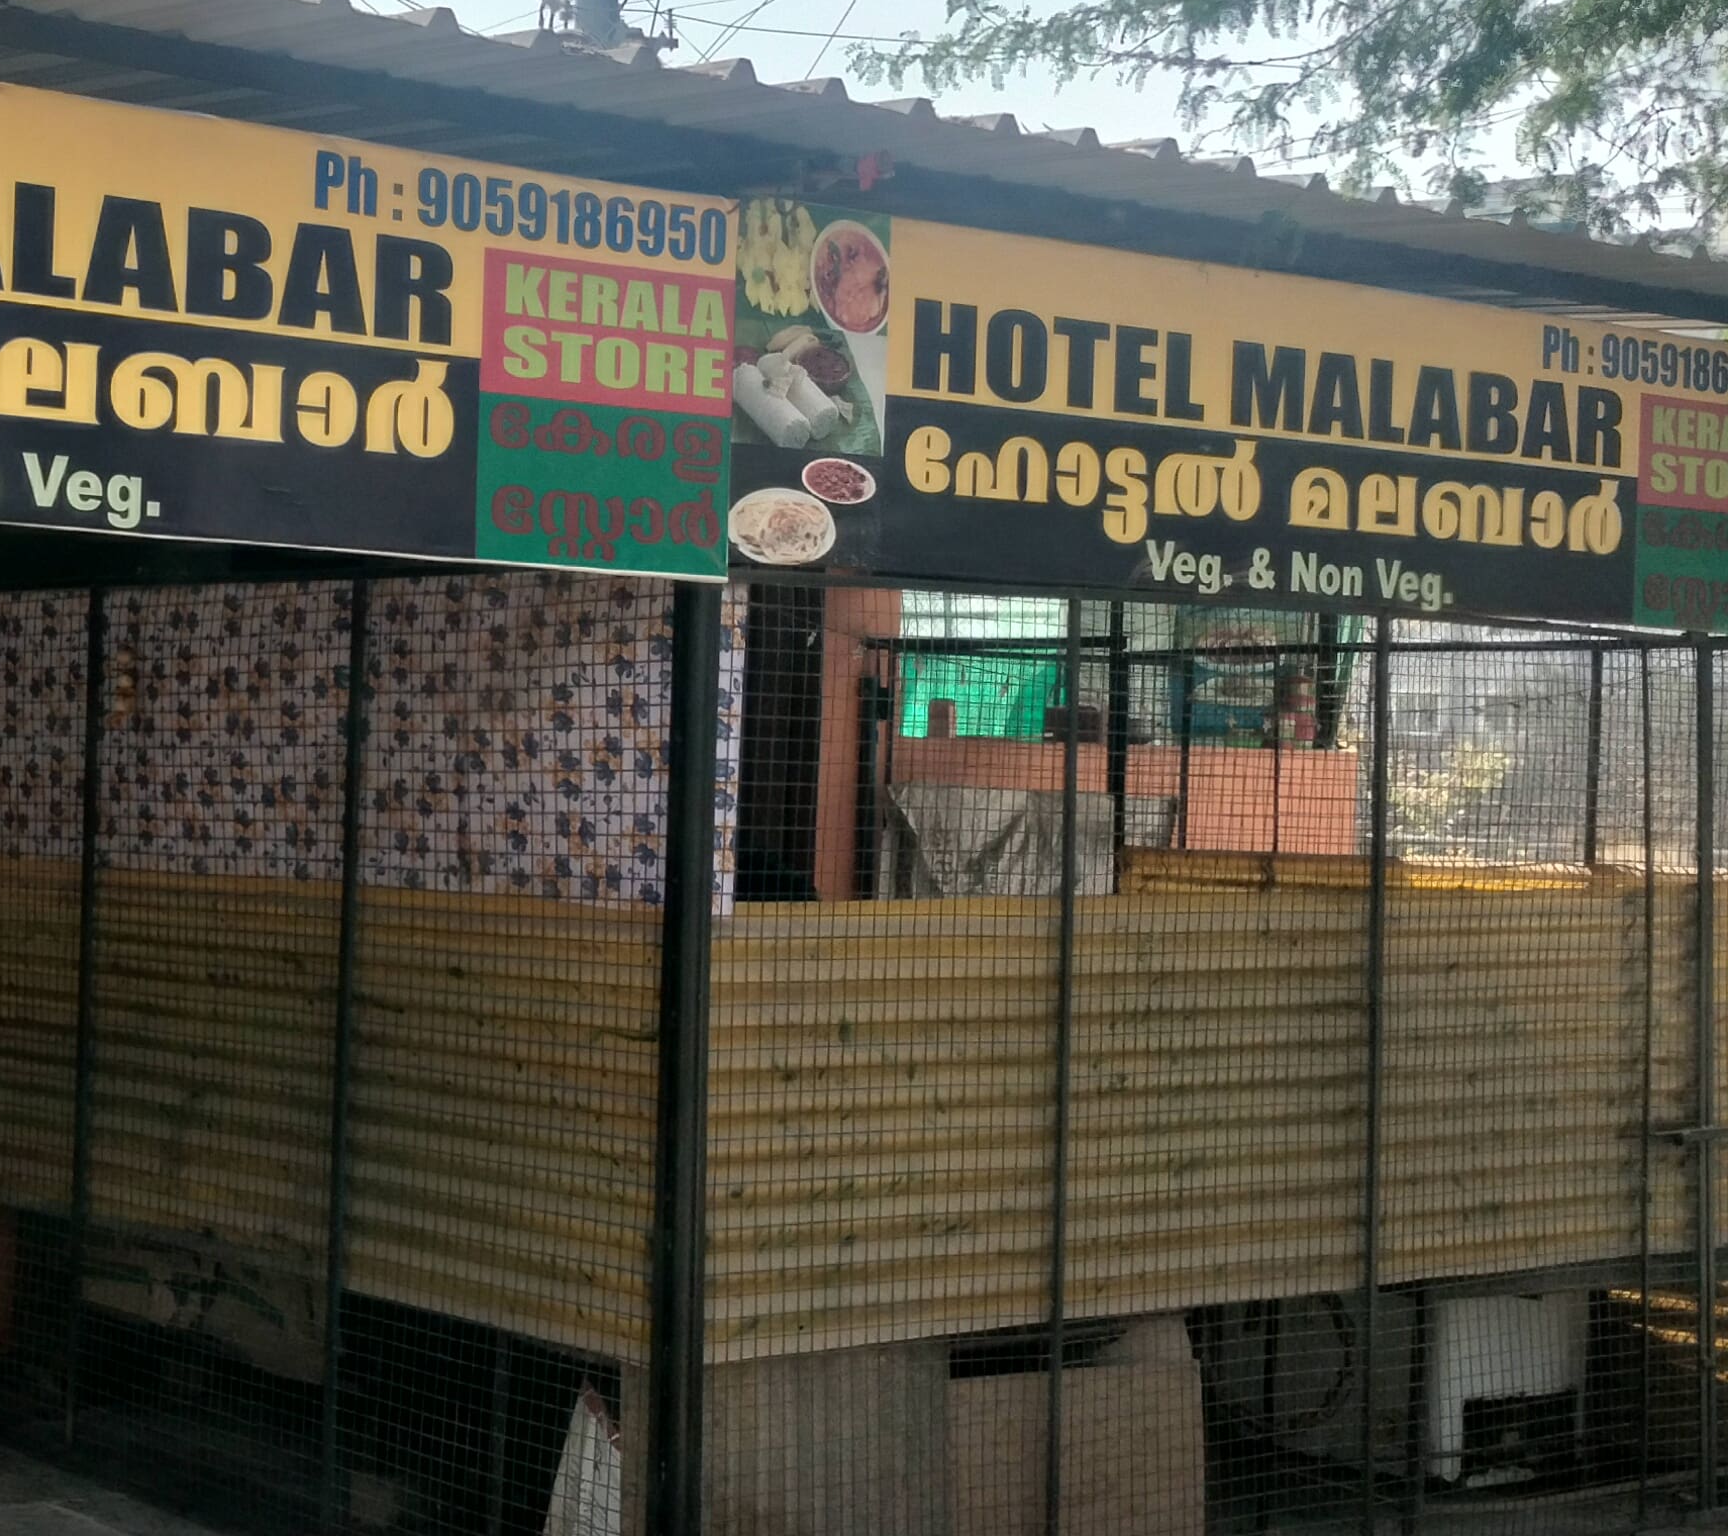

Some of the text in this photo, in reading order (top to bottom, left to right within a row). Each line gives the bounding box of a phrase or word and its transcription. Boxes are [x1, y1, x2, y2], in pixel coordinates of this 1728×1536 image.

[314, 149, 378, 217] Ph
[416, 166, 727, 265] 9059186950
[504, 262, 728, 341] KERALA
[501, 326, 727, 399] STORE
[912, 297, 1623, 469] HOTEL MALABAR
[1542, 324, 1581, 374] Ph
[489, 401, 723, 484] കേരള
[22, 451, 162, 529] Veg.
[490, 484, 722, 562] സ്റ്റോർ
[904, 425, 1623, 556] ഹോട്ടൽ മലബാർ
[1145, 539, 1454, 612] Veg. & Non Veg.
